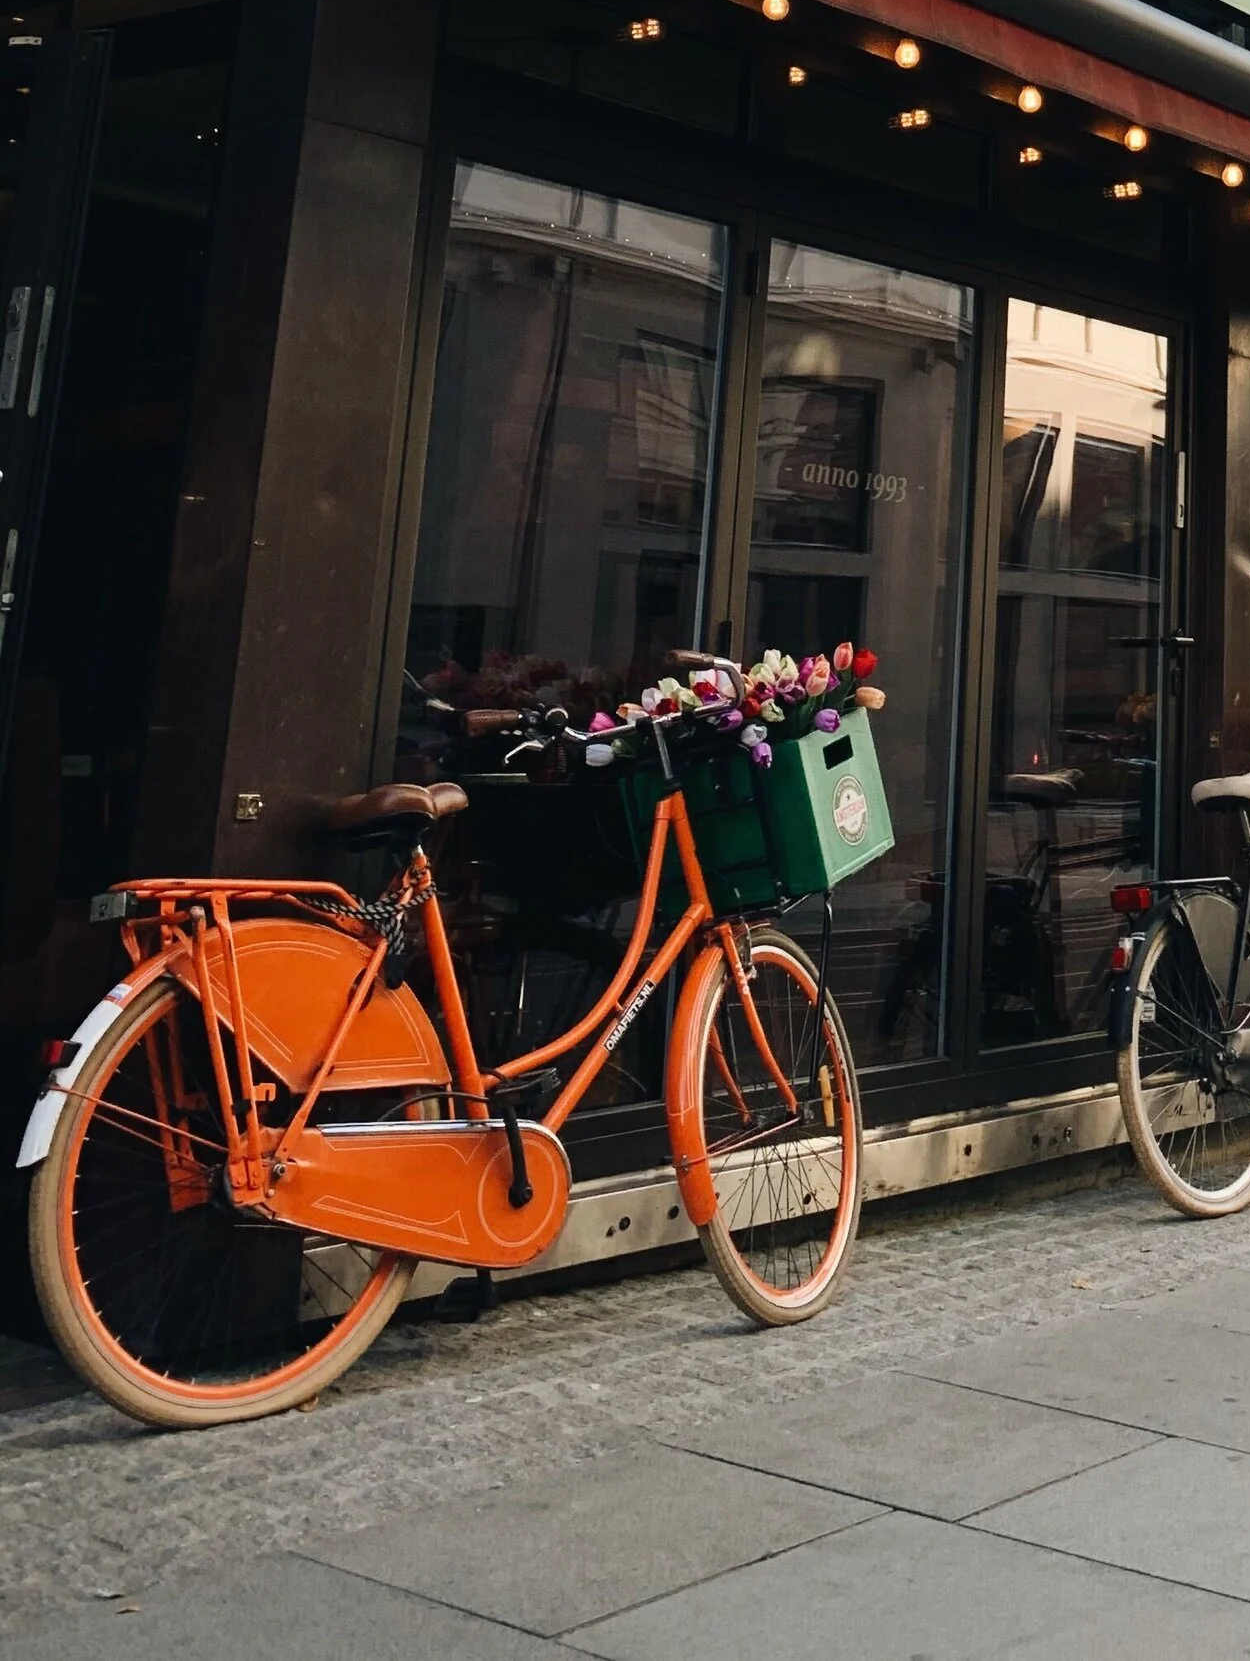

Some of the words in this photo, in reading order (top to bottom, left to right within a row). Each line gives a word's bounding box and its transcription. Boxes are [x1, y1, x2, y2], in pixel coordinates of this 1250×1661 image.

[802, 462, 859, 489] anno
[864, 472, 908, 503] 1993
[605, 983, 655, 1051] OMAFIETS.NL
